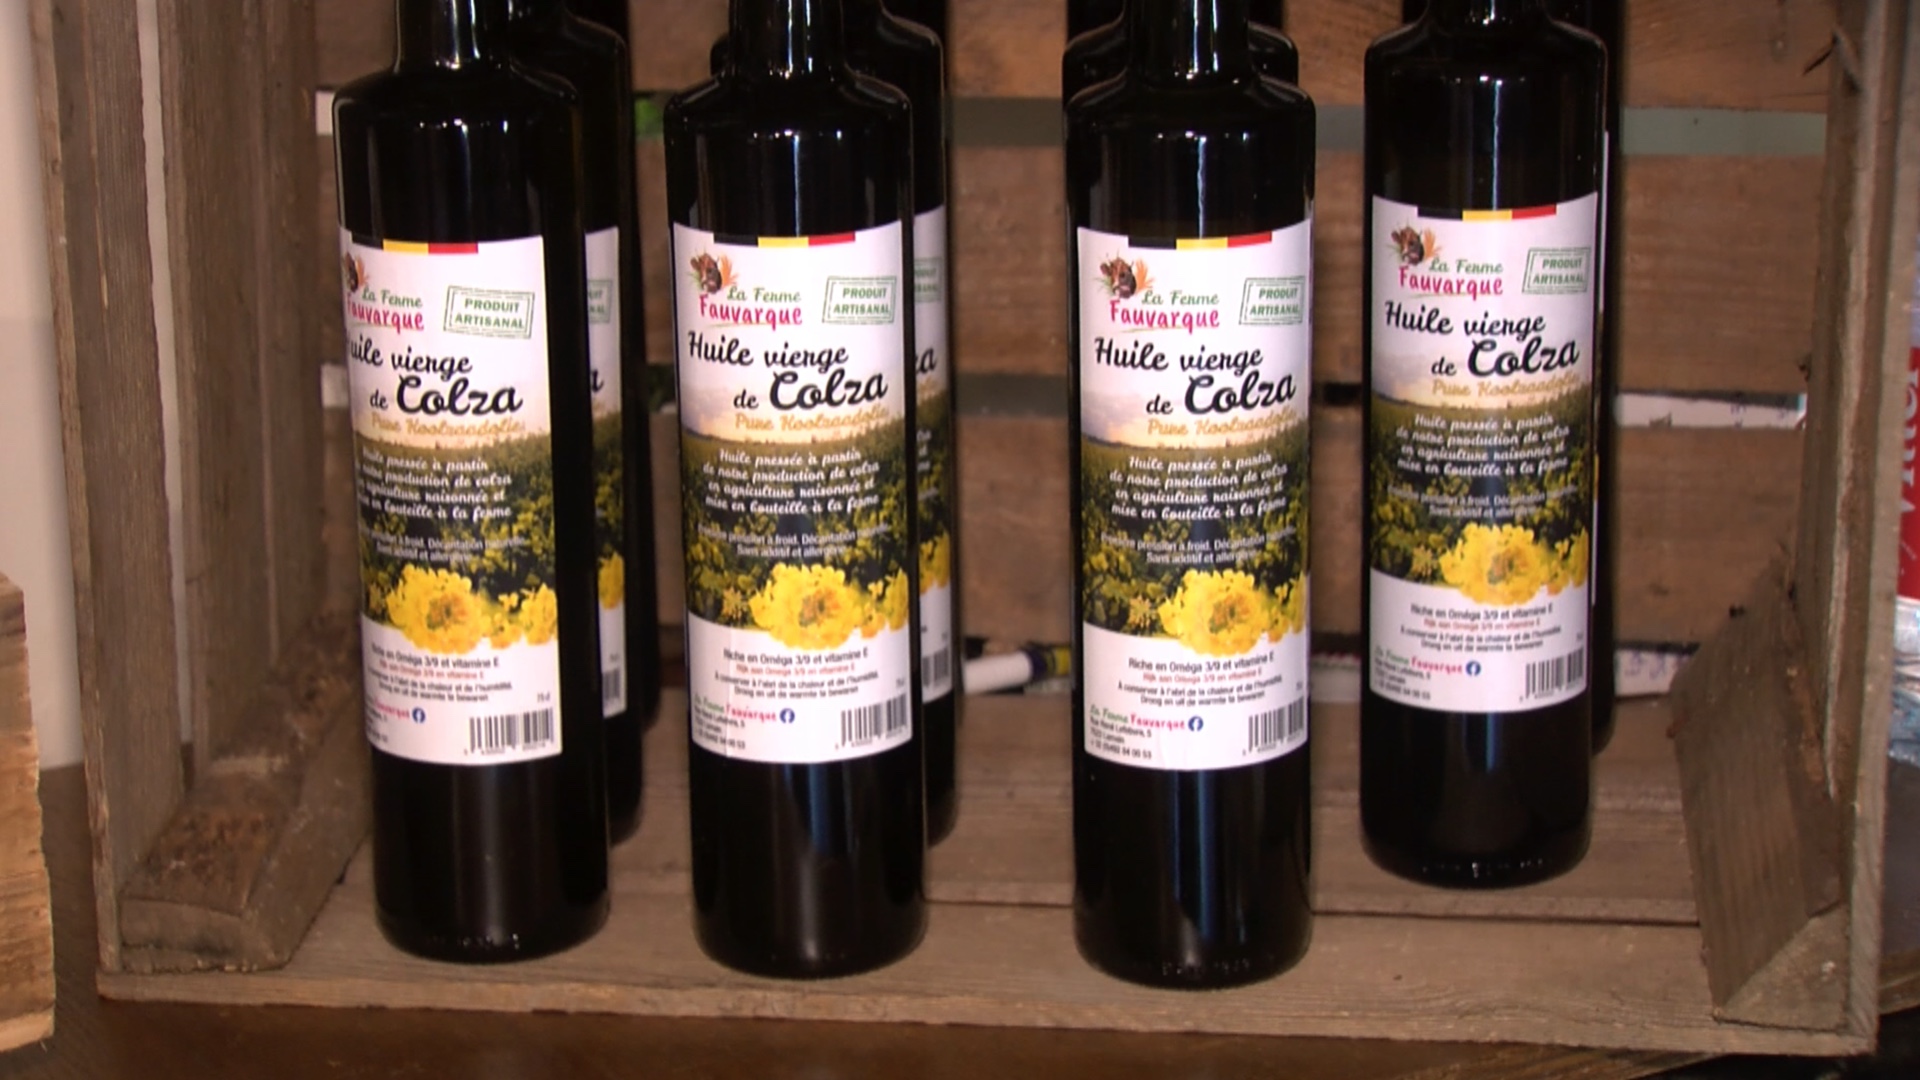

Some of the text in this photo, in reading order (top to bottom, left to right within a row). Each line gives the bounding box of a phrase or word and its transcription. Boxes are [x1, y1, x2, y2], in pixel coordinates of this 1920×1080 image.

[1429, 257, 1503, 274] La Ferme
[1543, 258, 1583, 269] PRODUIT
[1399, 265, 1504, 301] Fauvarque
[1533, 273, 1584, 283] ARTISANAL
[363, 287, 422, 307] La Ferme
[727, 286, 801, 303] La Ferme
[843, 288, 887, 299] PRODUIT
[1142, 290, 1219, 305] La Ferme
[1259, 288, 1299, 299] PRODUIT
[349, 296, 424, 334] auvarque
[464, 298, 519, 313] PRODUIT
[700, 294, 802, 331] Fauvarque
[834, 303, 890, 314] ARTISANAL
[1250, 304, 1299, 315] ARTISANAL
[455, 313, 524, 329] ARTISANAL
[1110, 299, 1220, 334] Fauvarque
[1385, 300, 1546, 341] Huile vierge
[349, 334, 472, 381] uile vierge
[688, 330, 849, 373] Huile vierge
[1094, 336, 1263, 376] Huile vierge
[1431, 336, 1580, 377] de Colza
[370, 375, 523, 415] de Colza
[734, 368, 888, 411] de Colza
[1146, 370, 1297, 415] de Colza
[1432, 380, 1471, 396] Pure
[372, 414, 401, 431] Pure
[734, 415, 774, 431] Pure
[1147, 418, 1188, 436] Pure
[1415, 412, 1553, 432] Huile pressée à partir
[1396, 425, 1569, 448] de notre production de colza
[720, 446, 861, 467] Huile pressée à partir
[1402, 440, 1564, 462] en agriculture raisonnée et
[387, 457, 427, 469] pressée
[433, 458, 441, 470] à
[447, 458, 488, 473] partir
[703, 461, 879, 483] de notre production de colza
[1130, 450, 1272, 474] Huile pressée à partir
[1398, 457, 1568, 476] mise en bouteille à la ferme
[385, 471, 449, 487] production
[455, 474, 472, 487] de
[475, 471, 512, 487] colza
[1110, 464, 1288, 490] de notre production de colza
[425, 488, 488, 503] raisonnée
[493, 489, 504, 501] et
[708, 478, 874, 499] en agriculture raisonnée et
[1116, 480, 1283, 506] en agriculture raisonnée et
[385, 499, 433, 518] bouteille
[438, 505, 447, 518] à
[453, 506, 468, 518] la
[473, 506, 512, 523] ferme
[706, 495, 879, 514] mise en bouteille à la ferme
[1112, 497, 1286, 520] mise en bouteille à la ferme
